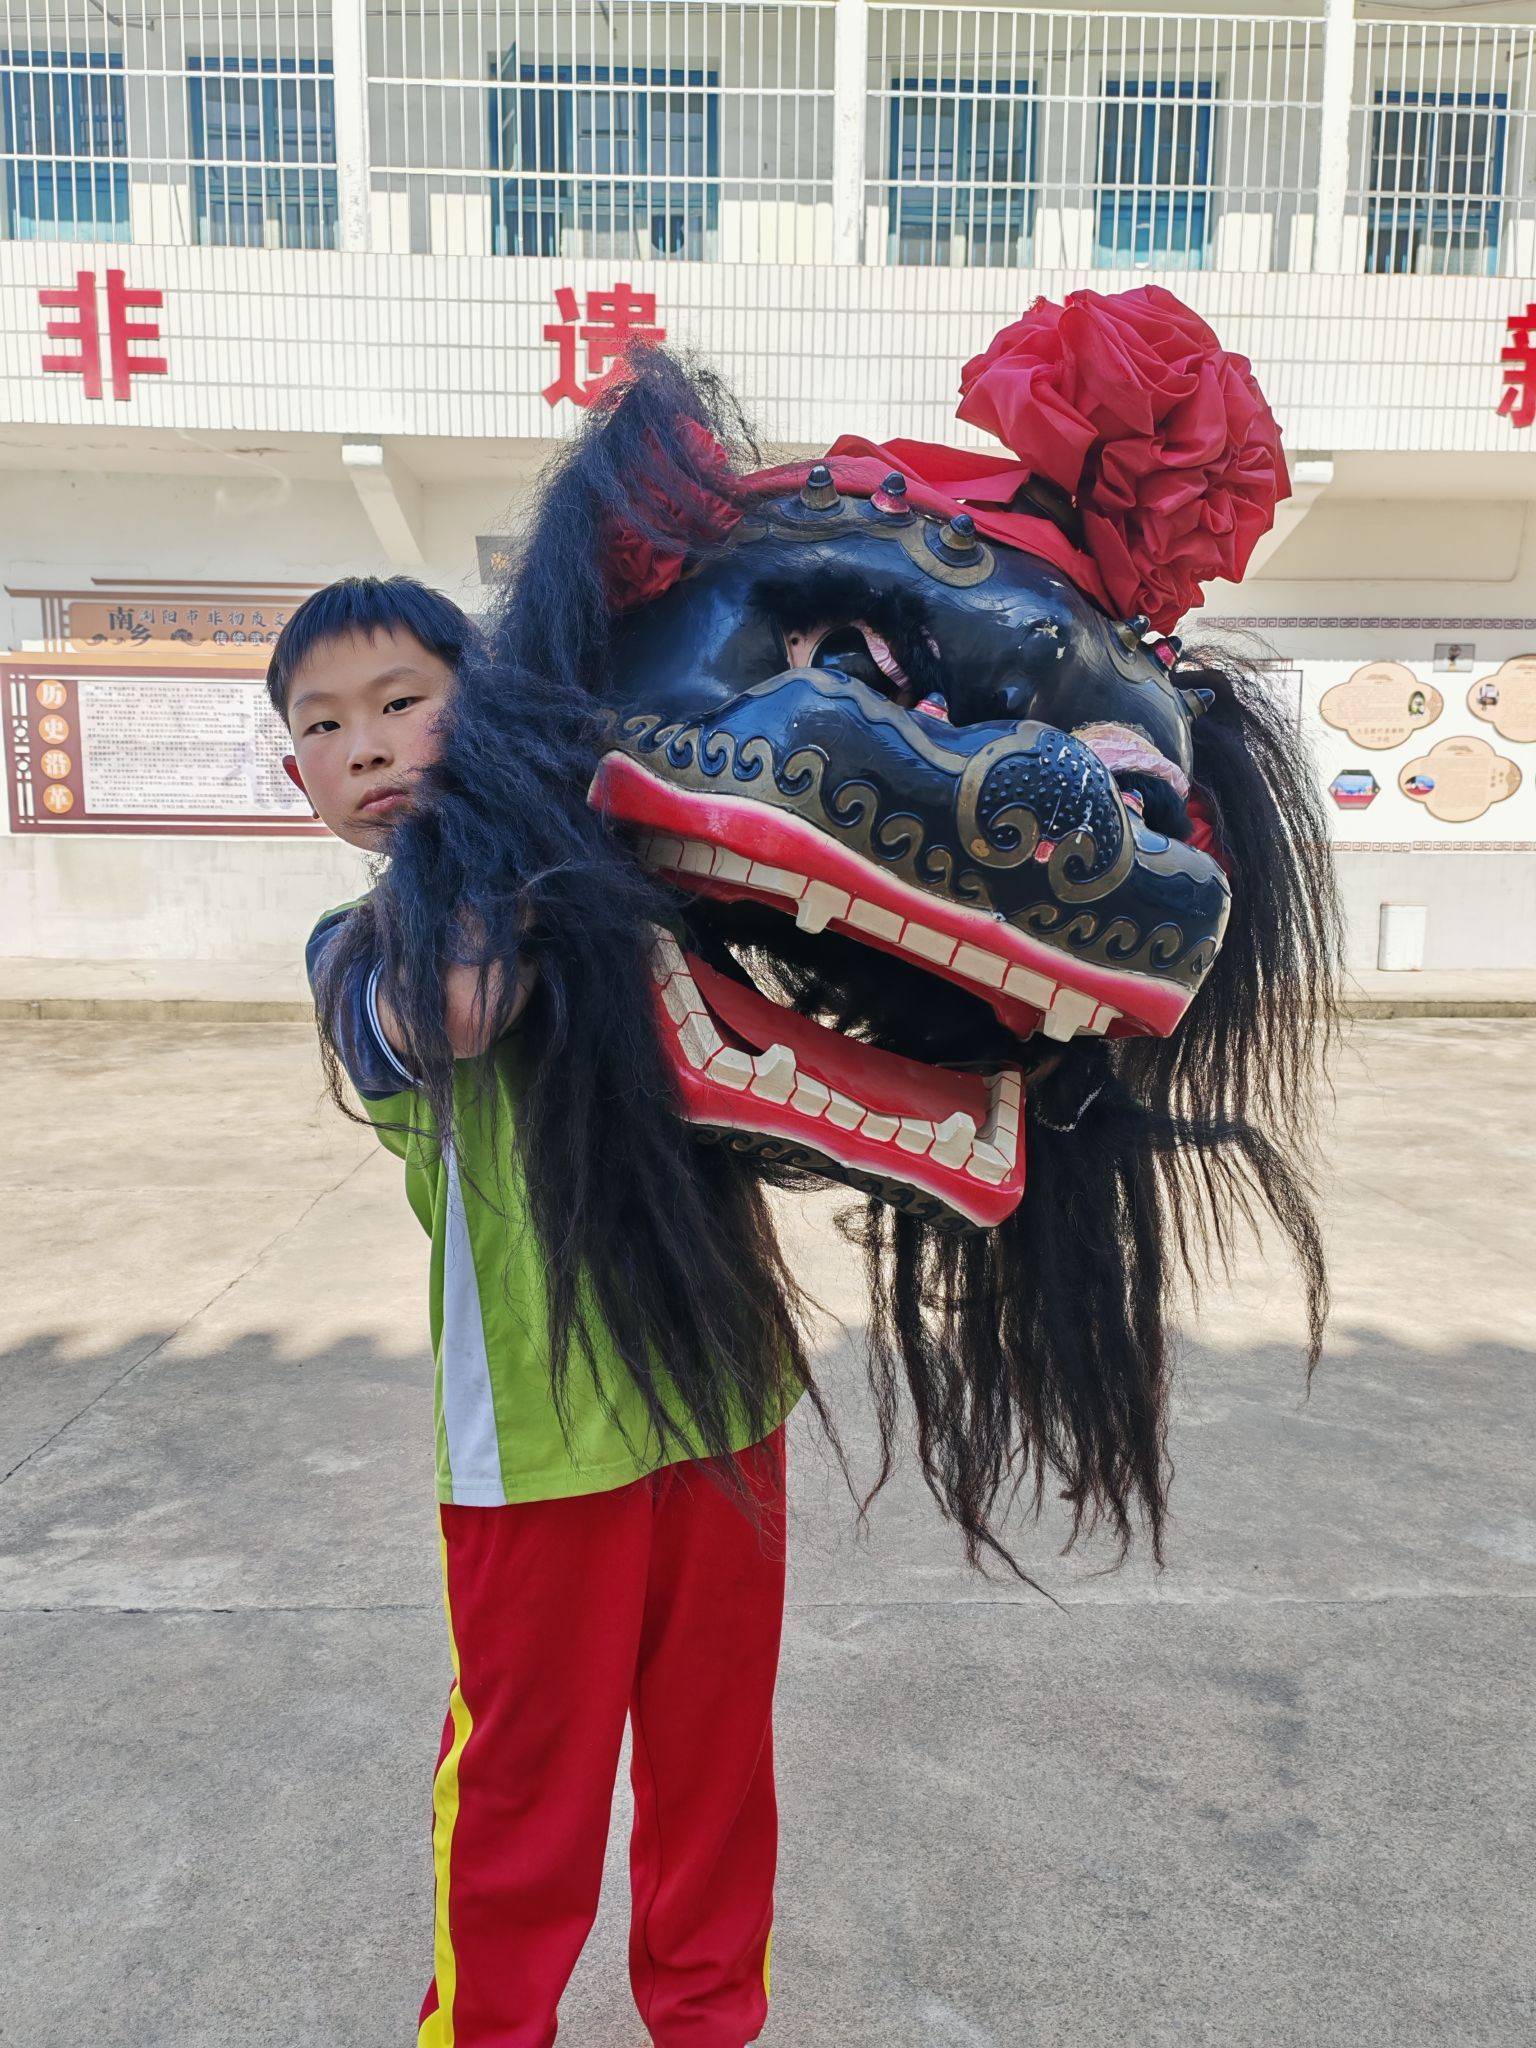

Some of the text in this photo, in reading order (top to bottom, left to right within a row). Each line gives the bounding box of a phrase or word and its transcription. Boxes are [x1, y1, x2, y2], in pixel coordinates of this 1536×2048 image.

[38, 270, 667, 408] 非 遗
[40, 687, 69, 809] 历史沿革
